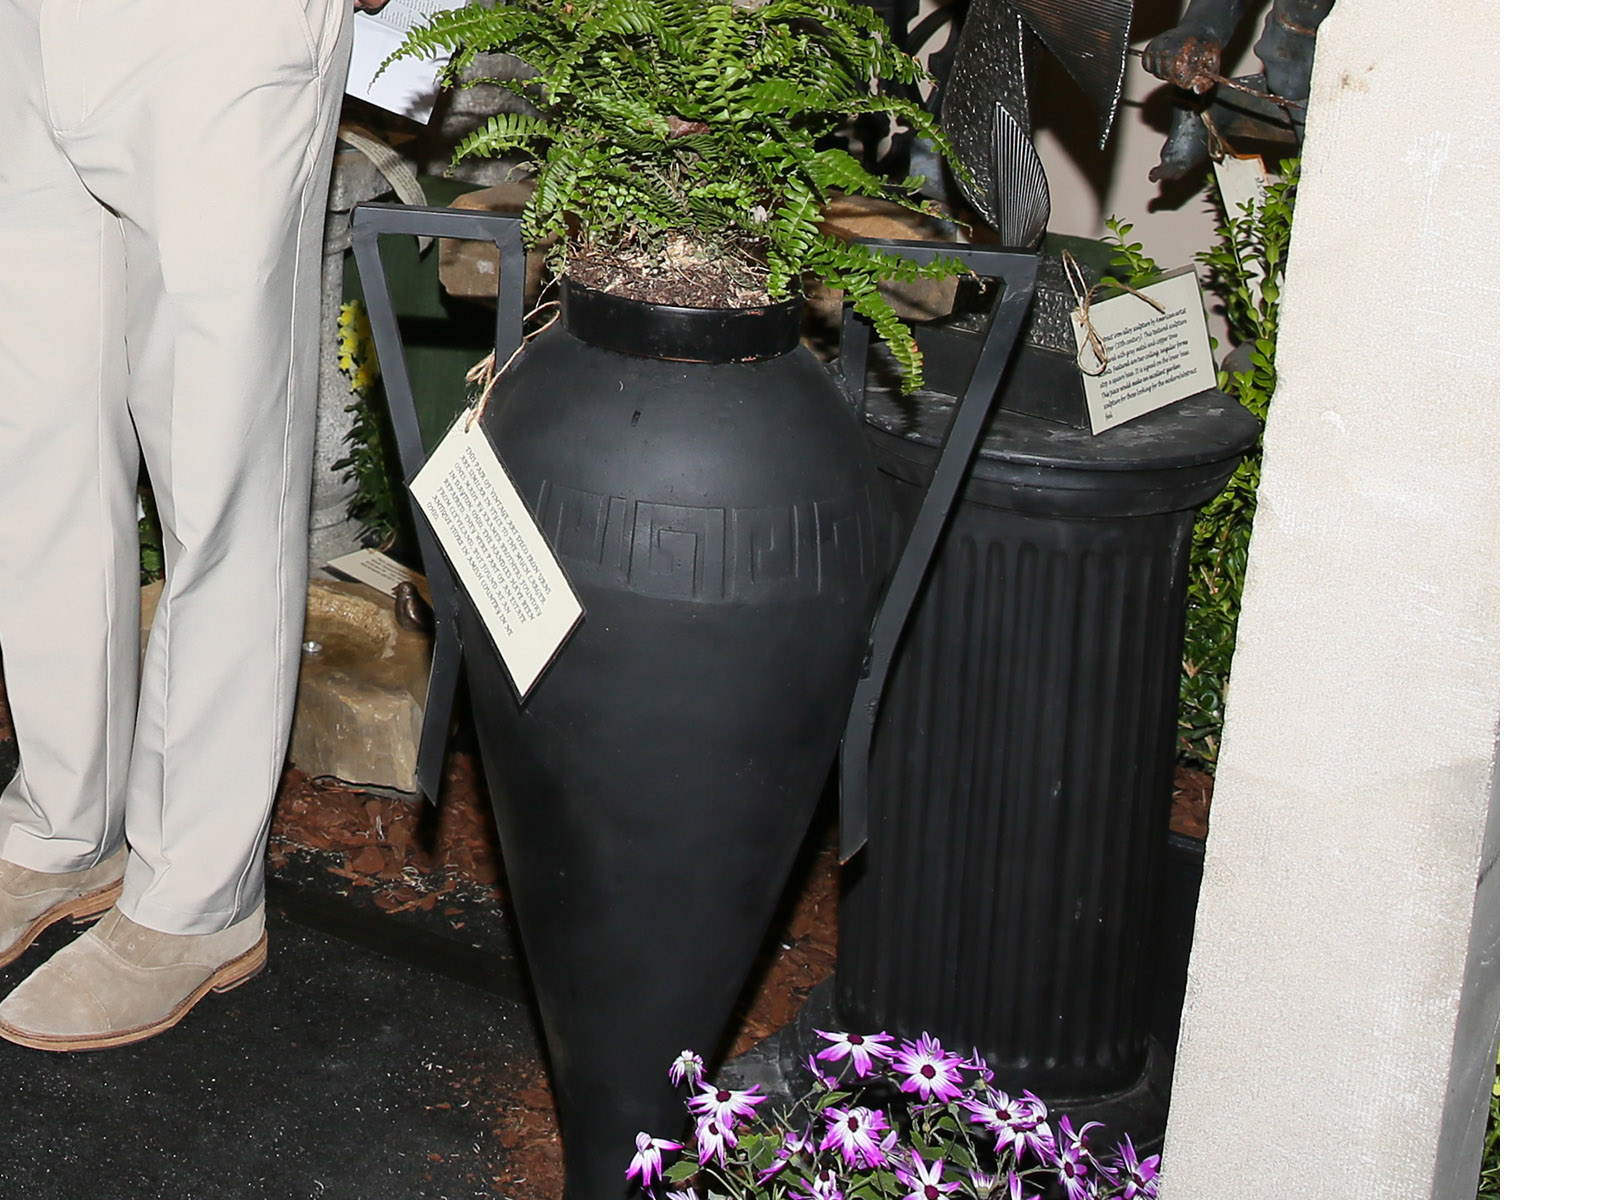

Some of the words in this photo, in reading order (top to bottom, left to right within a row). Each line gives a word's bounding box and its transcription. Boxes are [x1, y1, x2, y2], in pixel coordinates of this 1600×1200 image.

[432, 495, 451, 524] ANTIQUE
[449, 524, 463, 545] STORE
[466, 556, 483, 580] AMISH
[480, 579, 501, 614] COUNTRY
[437, 486, 451, 506] FROM
[472, 547, 483, 563] BUT
[480, 563, 497, 589] FOUND
[454, 462, 466, 480] ONES
[465, 480, 478, 501] MADE
[482, 511, 501, 543] KRAMER
[500, 542, 521, 579] BROTHERS
[519, 579, 542, 616] FOUNDRY
[459, 455, 470, 469] ARE
[468, 469, 485, 497] SIMILAR
[489, 506, 503, 526] STYLE
[506, 536, 517, 552] THE
[515, 551, 530, 575] MUCH
[527, 575, 545, 604] LARGER
[464, 513, 476, 534] THEY
[475, 531, 487, 553] WERE
[486, 553, 500, 573] PART
[509, 596, 526, 623] ESTATE
[465, 446, 476, 462] THIS
[474, 461, 485, 480] PAIR
[490, 487, 508, 519] VINTAGE
[506, 520, 518, 535] ART
[515, 534, 528, 554] DECO
[526, 553, 539, 573] IRON
[537, 572, 551, 594] URNS
[482, 528, 492, 544] THE
[491, 544, 511, 578] HANDLES
[509, 578, 523, 600] HAVE
[521, 599, 534, 620] BEEN
